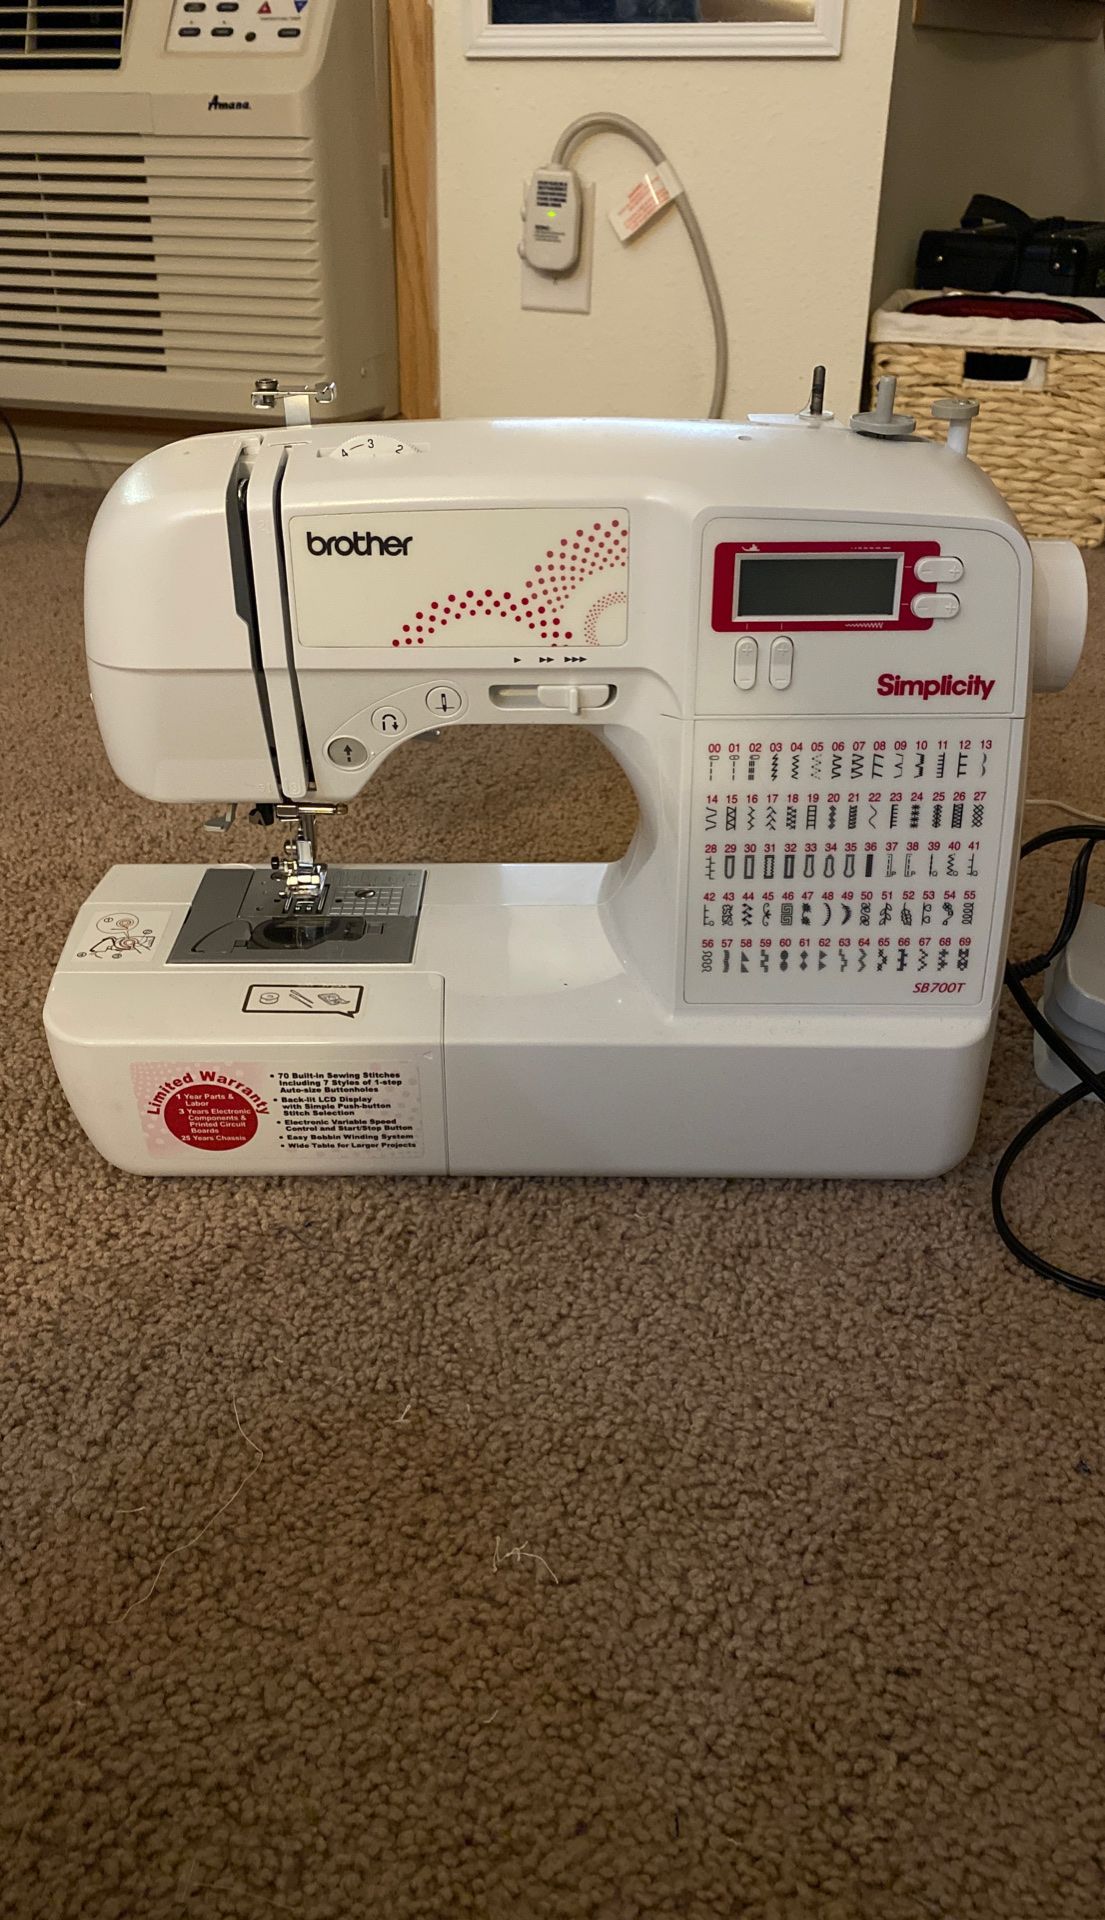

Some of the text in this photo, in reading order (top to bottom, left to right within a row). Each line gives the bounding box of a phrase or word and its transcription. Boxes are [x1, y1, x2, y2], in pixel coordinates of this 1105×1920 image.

[208, 95, 250, 111] Amana
[341, 438, 404, 457] 4 3 2
[306, 531, 413, 556] brother
[877, 673, 995, 700] Simplicity
[708, 740, 992, 753] 00 01 02 03 04 05 06 07 08 09 10 11 12 13
[707, 791, 986, 804] 14 15 16 17 18 19 20 21 22 23 24 25 26 27
[705, 841, 980, 853] 28 29 30 31 32 33 34 35 36 37 38 39 40 41
[704, 891, 976, 901] 42 43 44 45 46 47 48 49 50 51 52 53 54 55
[702, 937, 971, 948] 56 57 58 59 60 61 62 63 64 65 66 67 68 69
[913, 983, 966, 993] SB700T
[147, 1070, 270, 1115] Limited Warranty
